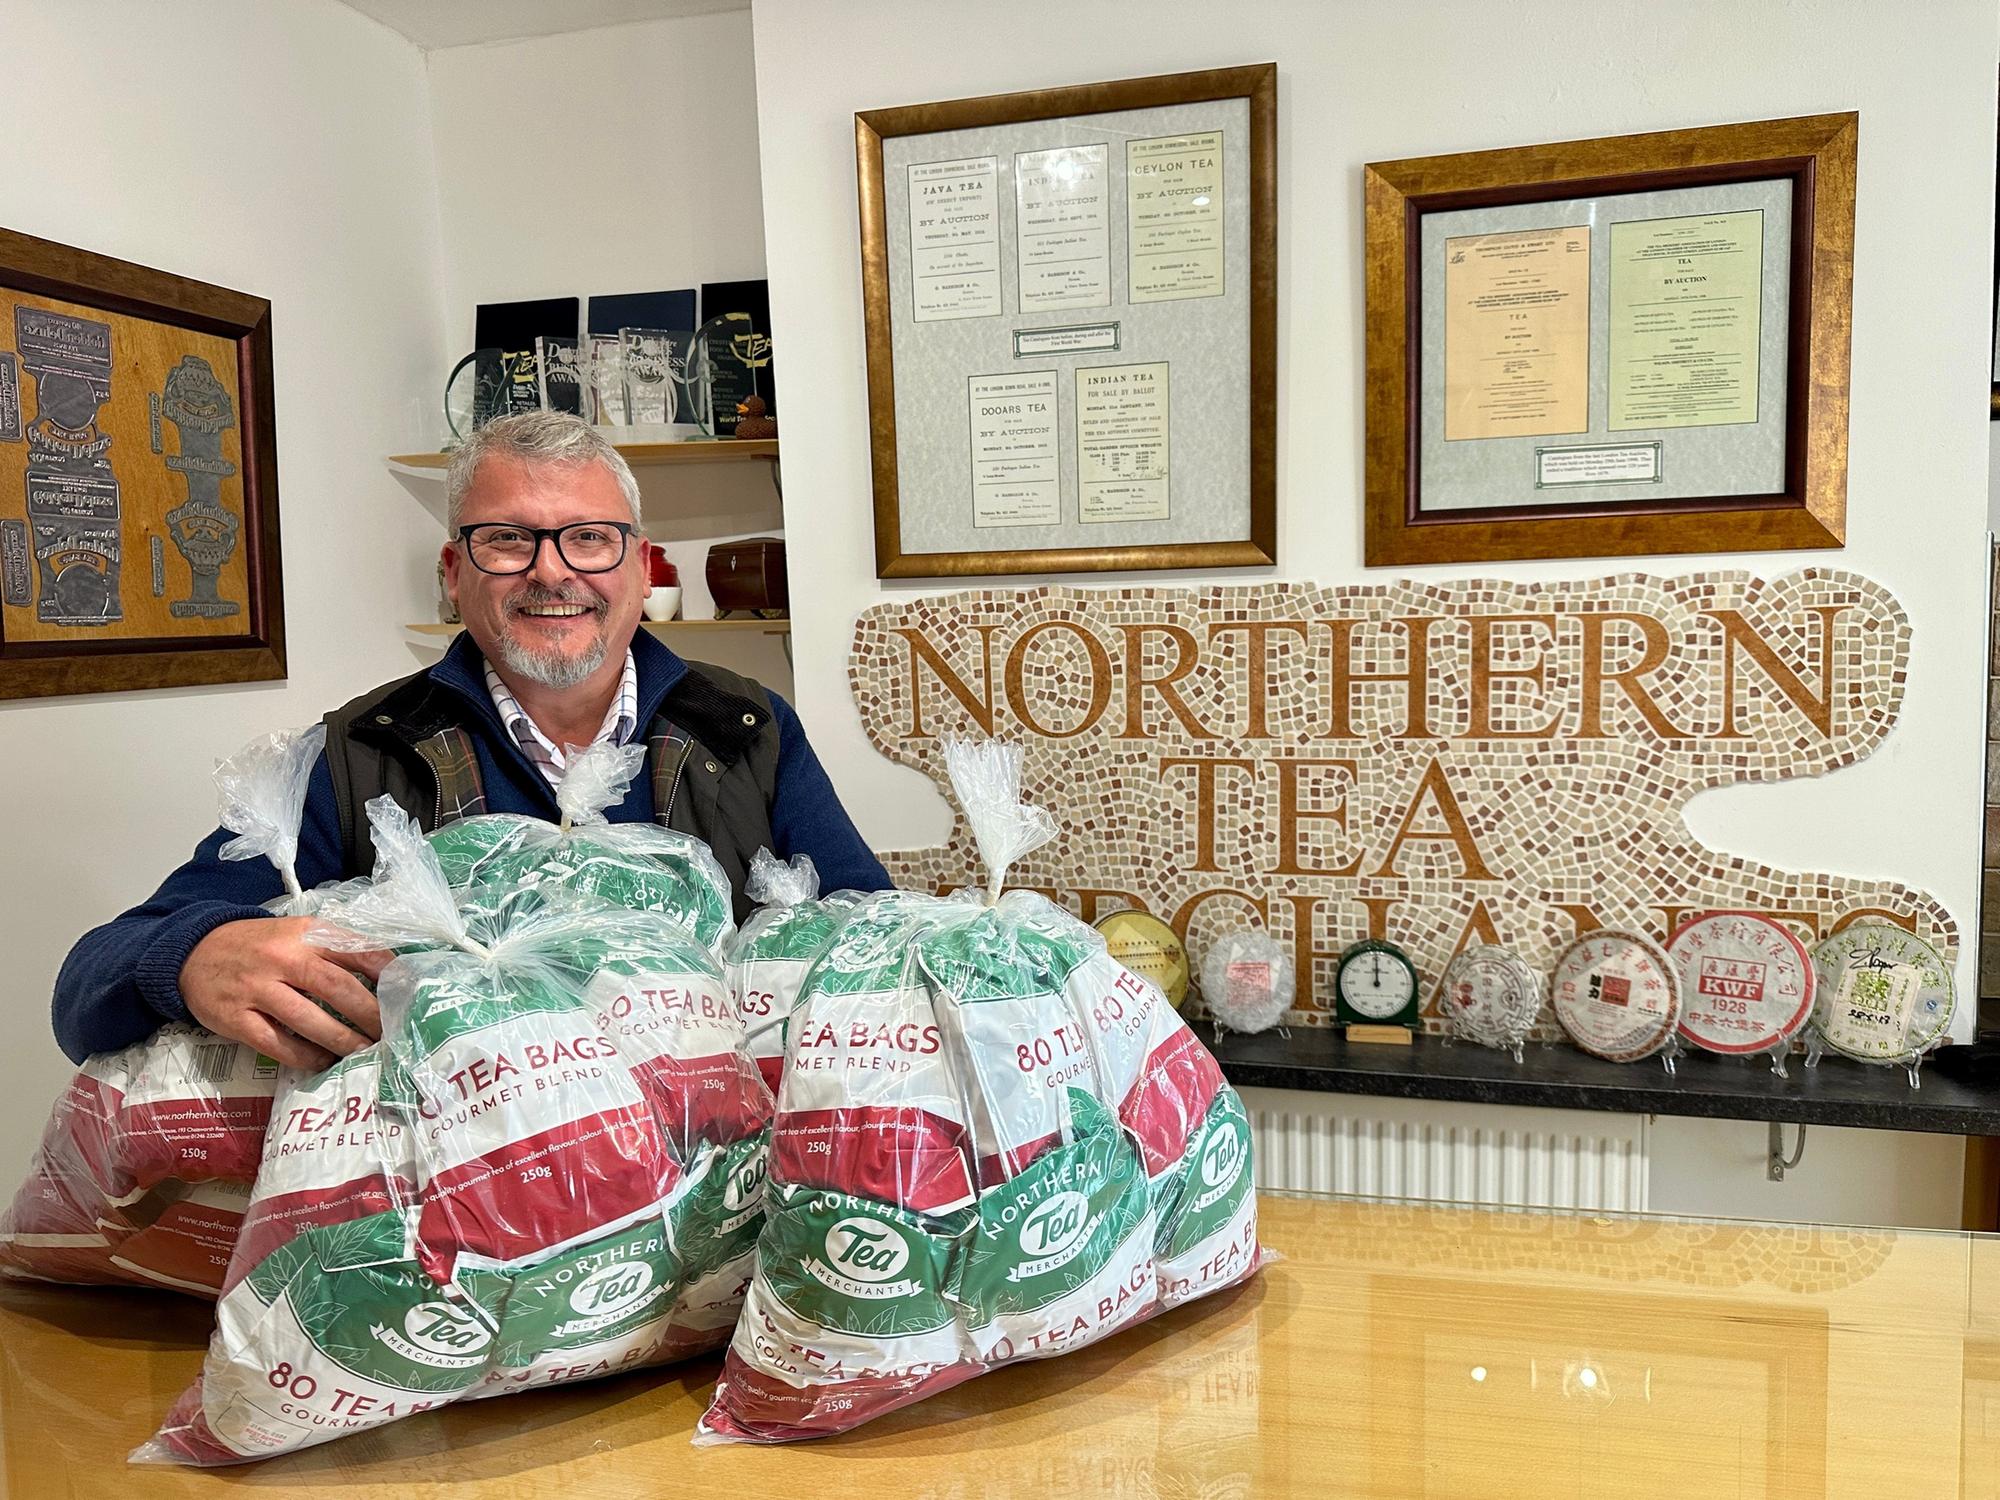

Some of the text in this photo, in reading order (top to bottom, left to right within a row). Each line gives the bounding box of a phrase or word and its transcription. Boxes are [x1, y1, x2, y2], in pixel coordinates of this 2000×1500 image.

[1135, 158, 1214, 175] CEYLON TEA
[923, 181, 983, 195] JAVA TEA
[1158, 185, 1213, 197] AUCTION
[920, 213, 990, 227] BY AUCTION
[1674, 276, 1708, 284] AUCTION
[1088, 373, 1154, 385] INDIAN TEA
[981, 403, 1047, 416] DOOARS TEA
[1000, 426, 1051, 436] AUCTION
[893, 604, 1850, 741] NORTHERN
[1159, 756, 1502, 882] TEA
[741, 990, 775, 1016] GS
[1093, 995, 1125, 1034] 80
[1114, 971, 1145, 1002] TE
[1703, 977, 1760, 998] KWF
[641, 988, 696, 1015] TEA
[701, 994, 734, 1021] BA
[1124, 989, 1159, 1037] GOURM
[1711, 998, 1748, 1015] 1928
[799, 1020, 940, 1054] EA BAGS
[447, 1036, 619, 1101] TEA BAGS
[696, 1065, 725, 1075] excellent
[1016, 1037, 1053, 1073] 80
[702, 1079, 726, 1091] 250g
[1046, 1056, 1096, 1088] GOURME
[151, 1109, 252, 1121] www.northern-tea.com
[283, 1096, 378, 1136] TEA BA
[431, 1067, 603, 1140] GOURMET BLEND
[787, 1127, 799, 1136] tea
[799, 1125, 808, 1135] of
[808, 1124, 834, 1134] excellent
[834, 1122, 861, 1134] flavour,
[881, 1119, 897, 1129] and
[180, 1148, 208, 1160] 250g
[265, 1136, 329, 1162] OURMET
[806, 1141, 832, 1156] 250g
[1206, 1132, 1237, 1180] Tea
[429, 1186, 457, 1203] quality
[457, 1172, 491, 1193] gourmet
[491, 1166, 505, 1177] tea
[505, 1158, 515, 1171] of
[515, 1149, 549, 1167] excellent
[548, 1139, 579, 1154] flavour,
[579, 1129, 603, 1142] colour
[520, 1166, 553, 1185] 250g
[284, 1207, 292, 1218] of
[292, 1203, 319, 1216] excellent
[319, 1197, 350, 1211] flavour,
[984, 1159, 1102, 1241] NORTHERN
[1026, 1201, 1080, 1250] Tea
[837, 1224, 899, 1273] Tea
[1025, 1223, 1096, 1275] MERCHANTS
[1199, 1240, 1240, 1282] TEA
[579, 1264, 644, 1310] Tea
[816, 1266, 904, 1296] MERCHANTS
[571, 1290, 659, 1331] MERCHANTS
[414, 1306, 482, 1348] Tea
[1028, 1315, 1090, 1350] TEA
[386, 1335, 476, 1366] MERCHANTS
[548, 1337, 662, 1382] TEA BA
[268, 1362, 318, 1400] 80
[823, 1398, 854, 1413] 250g
